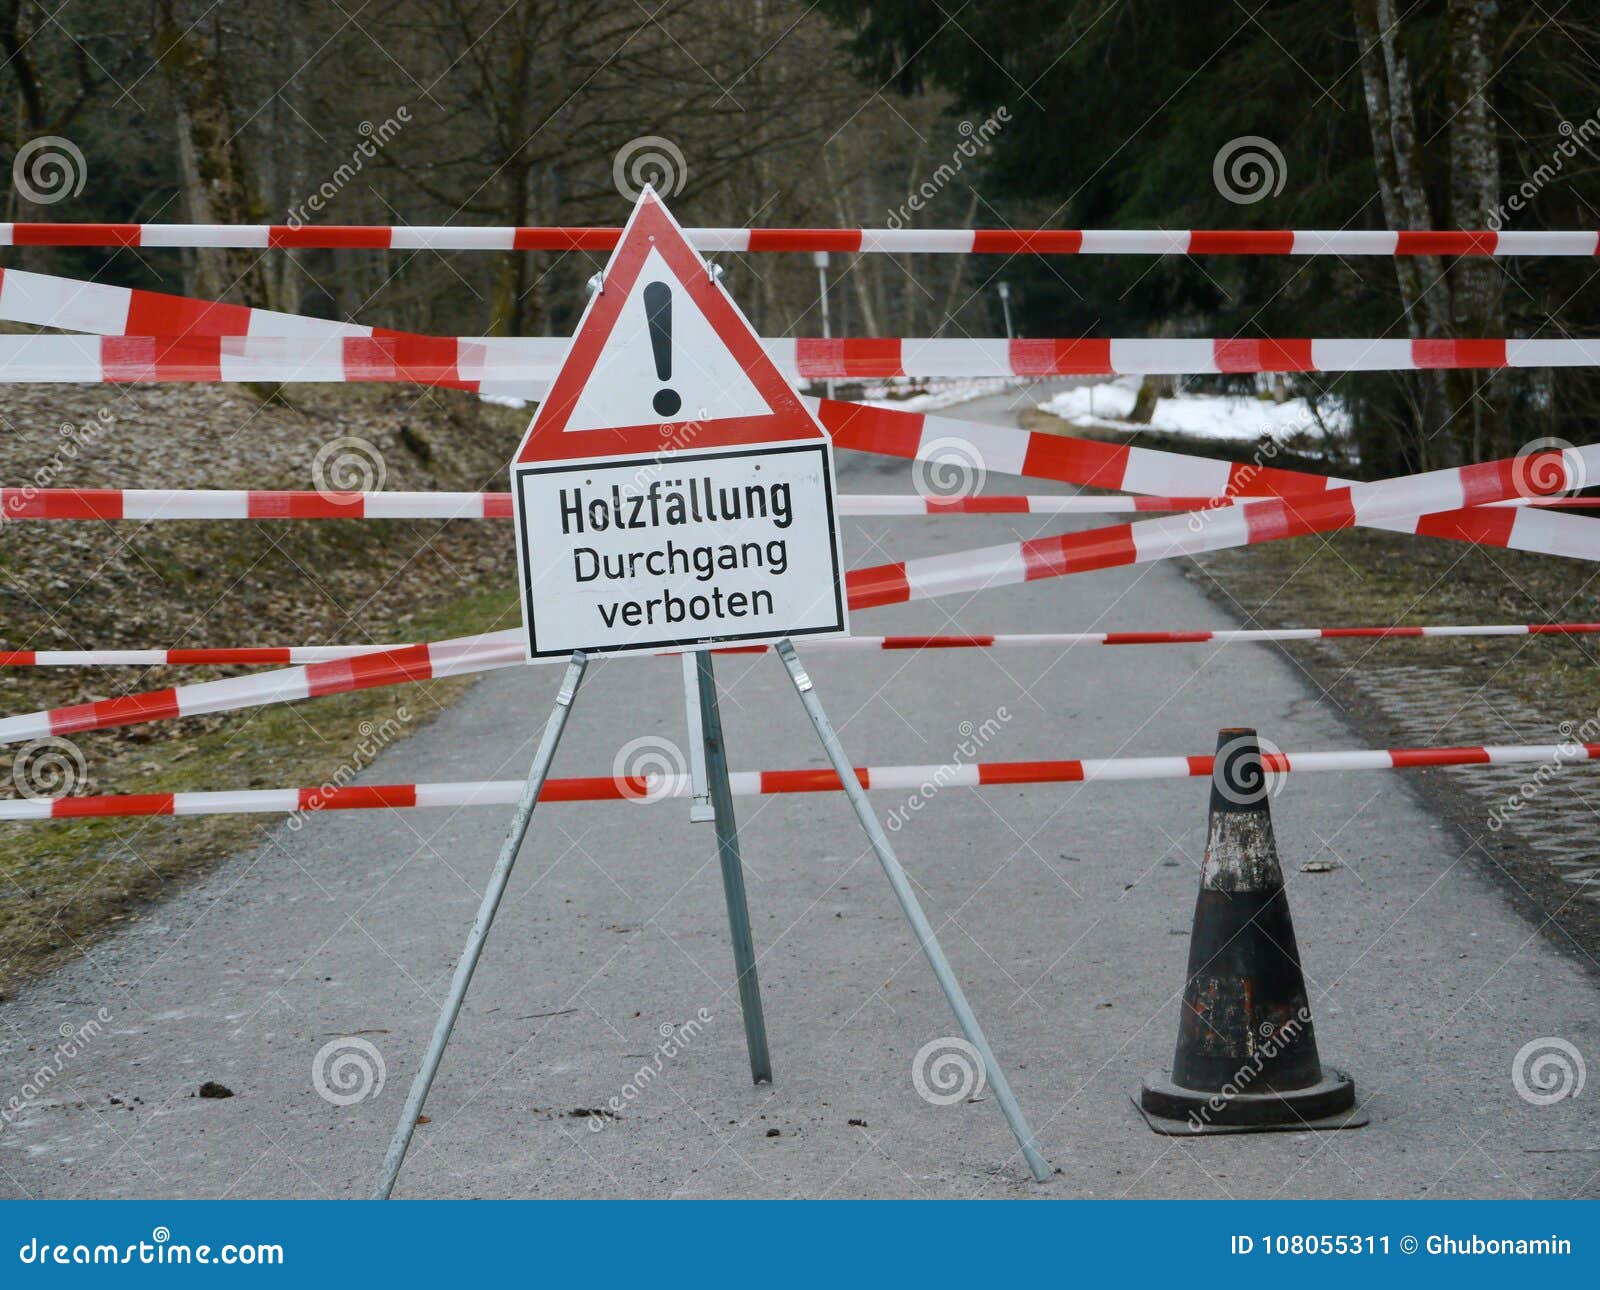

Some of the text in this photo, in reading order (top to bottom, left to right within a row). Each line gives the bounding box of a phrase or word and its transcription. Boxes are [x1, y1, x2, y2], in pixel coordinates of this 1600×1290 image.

[559, 477, 793, 534] Holzfällung
[573, 539, 788, 583] Durchgang
[597, 587, 774, 628] verboten
